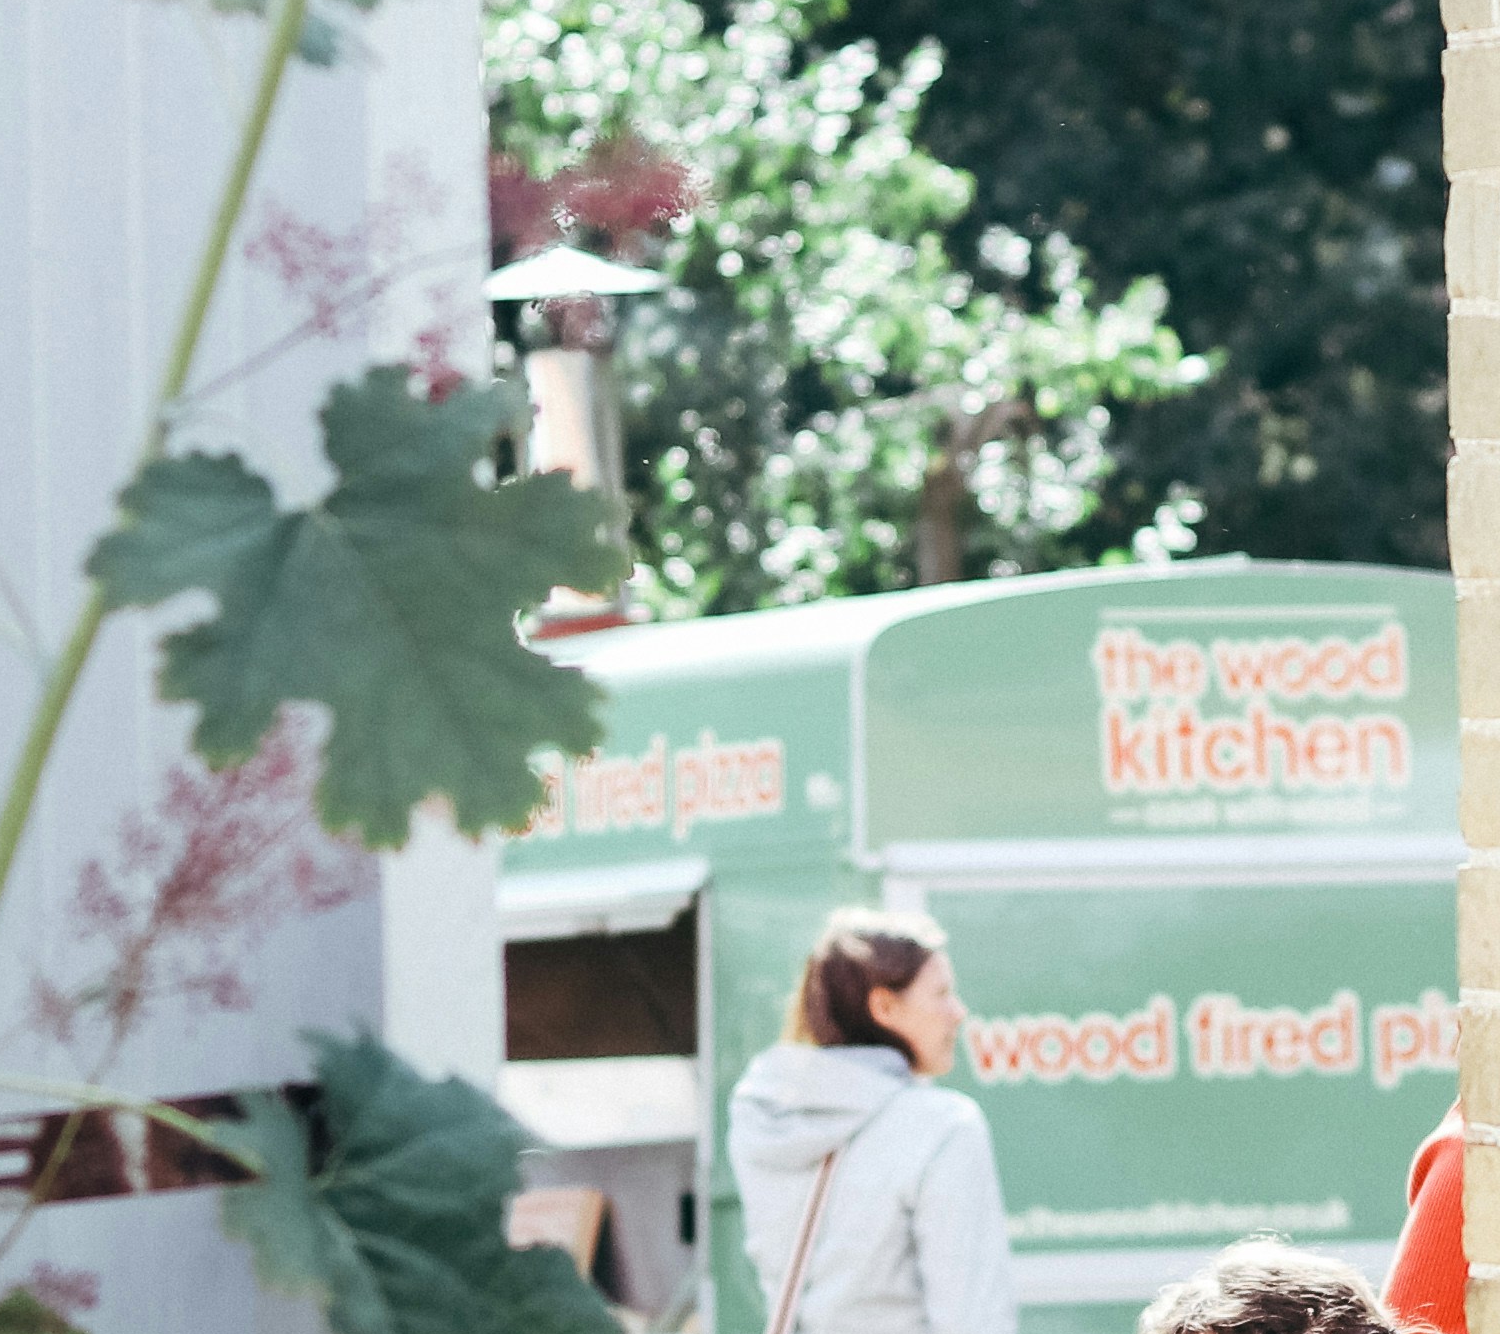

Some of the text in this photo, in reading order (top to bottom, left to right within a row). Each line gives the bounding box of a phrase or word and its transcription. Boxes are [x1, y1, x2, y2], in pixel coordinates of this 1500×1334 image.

[1094, 624, 1404, 697] the wood
[674, 731, 783, 839] pizza
[1104, 701, 1408, 789] kitchen
[969, 995, 1172, 1078] wood
[1190, 993, 1359, 1076] fired
